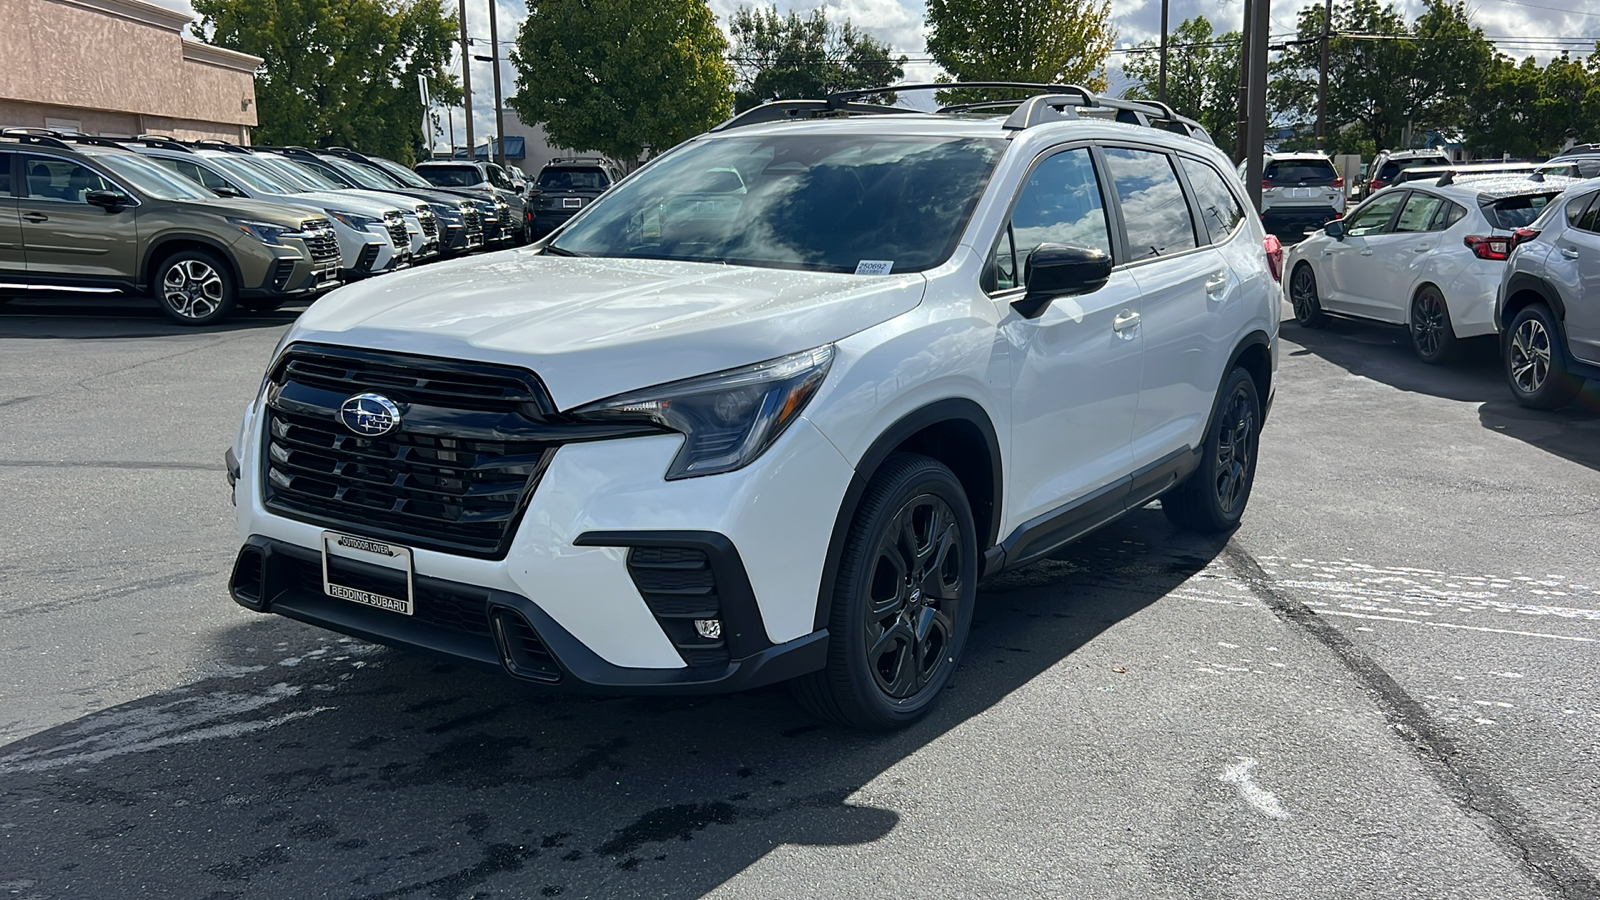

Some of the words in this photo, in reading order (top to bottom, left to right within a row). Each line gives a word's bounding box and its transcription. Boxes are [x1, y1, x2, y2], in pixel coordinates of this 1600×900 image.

[858, 262, 887, 270] 250692
[342, 537, 369, 550] OUTDOOR
[370, 543, 389, 554] LOVER
[331, 586, 368, 603] REDDING
[370, 595, 405, 612] SUBARU
